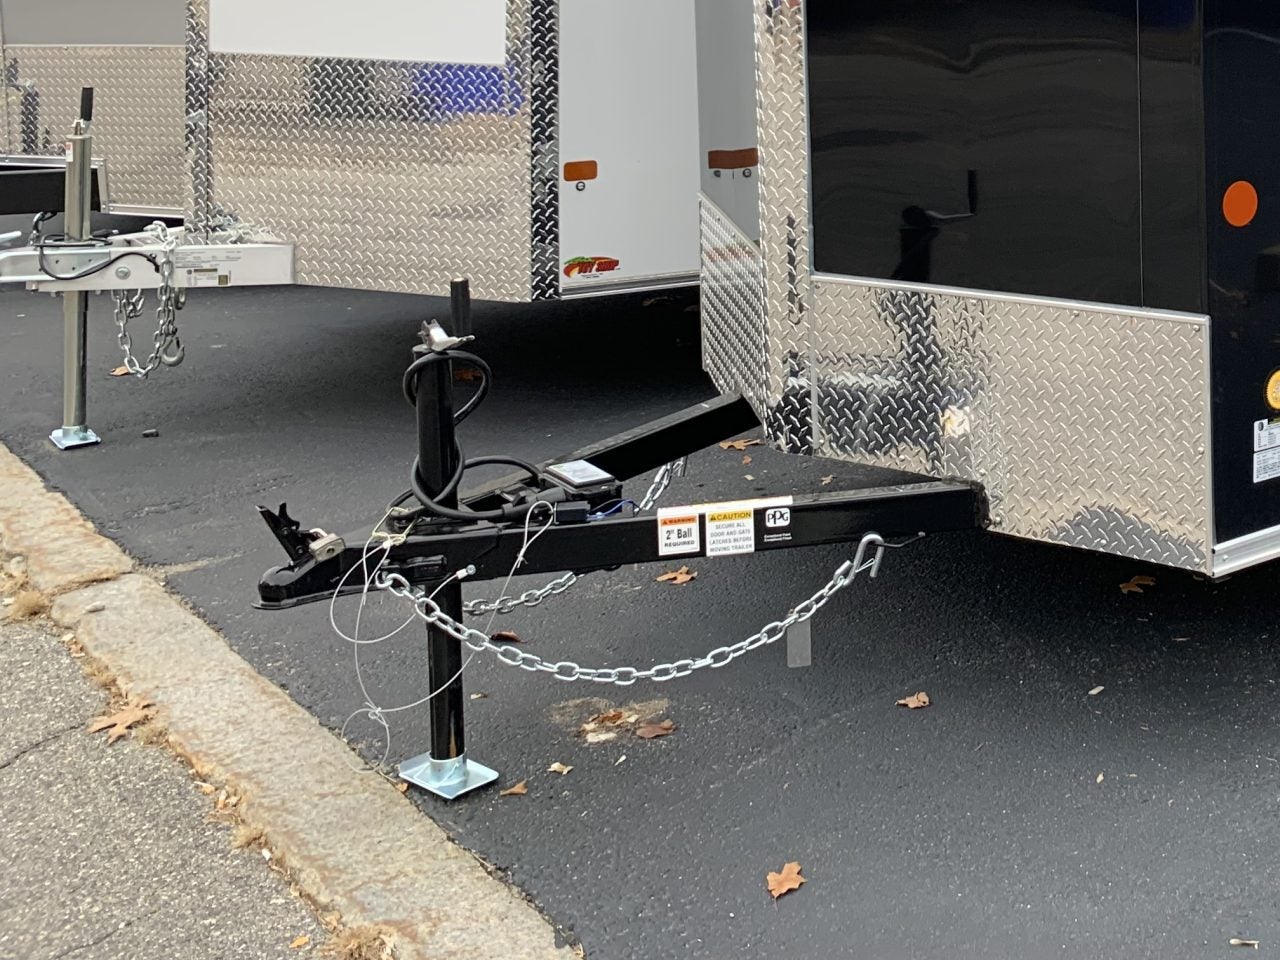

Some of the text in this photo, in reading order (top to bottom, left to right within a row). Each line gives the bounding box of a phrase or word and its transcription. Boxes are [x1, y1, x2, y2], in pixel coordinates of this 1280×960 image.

[717, 512, 751, 521] CAUTION
[767, 510, 789, 524] PPG
[666, 528, 692, 540] 2" Ball
